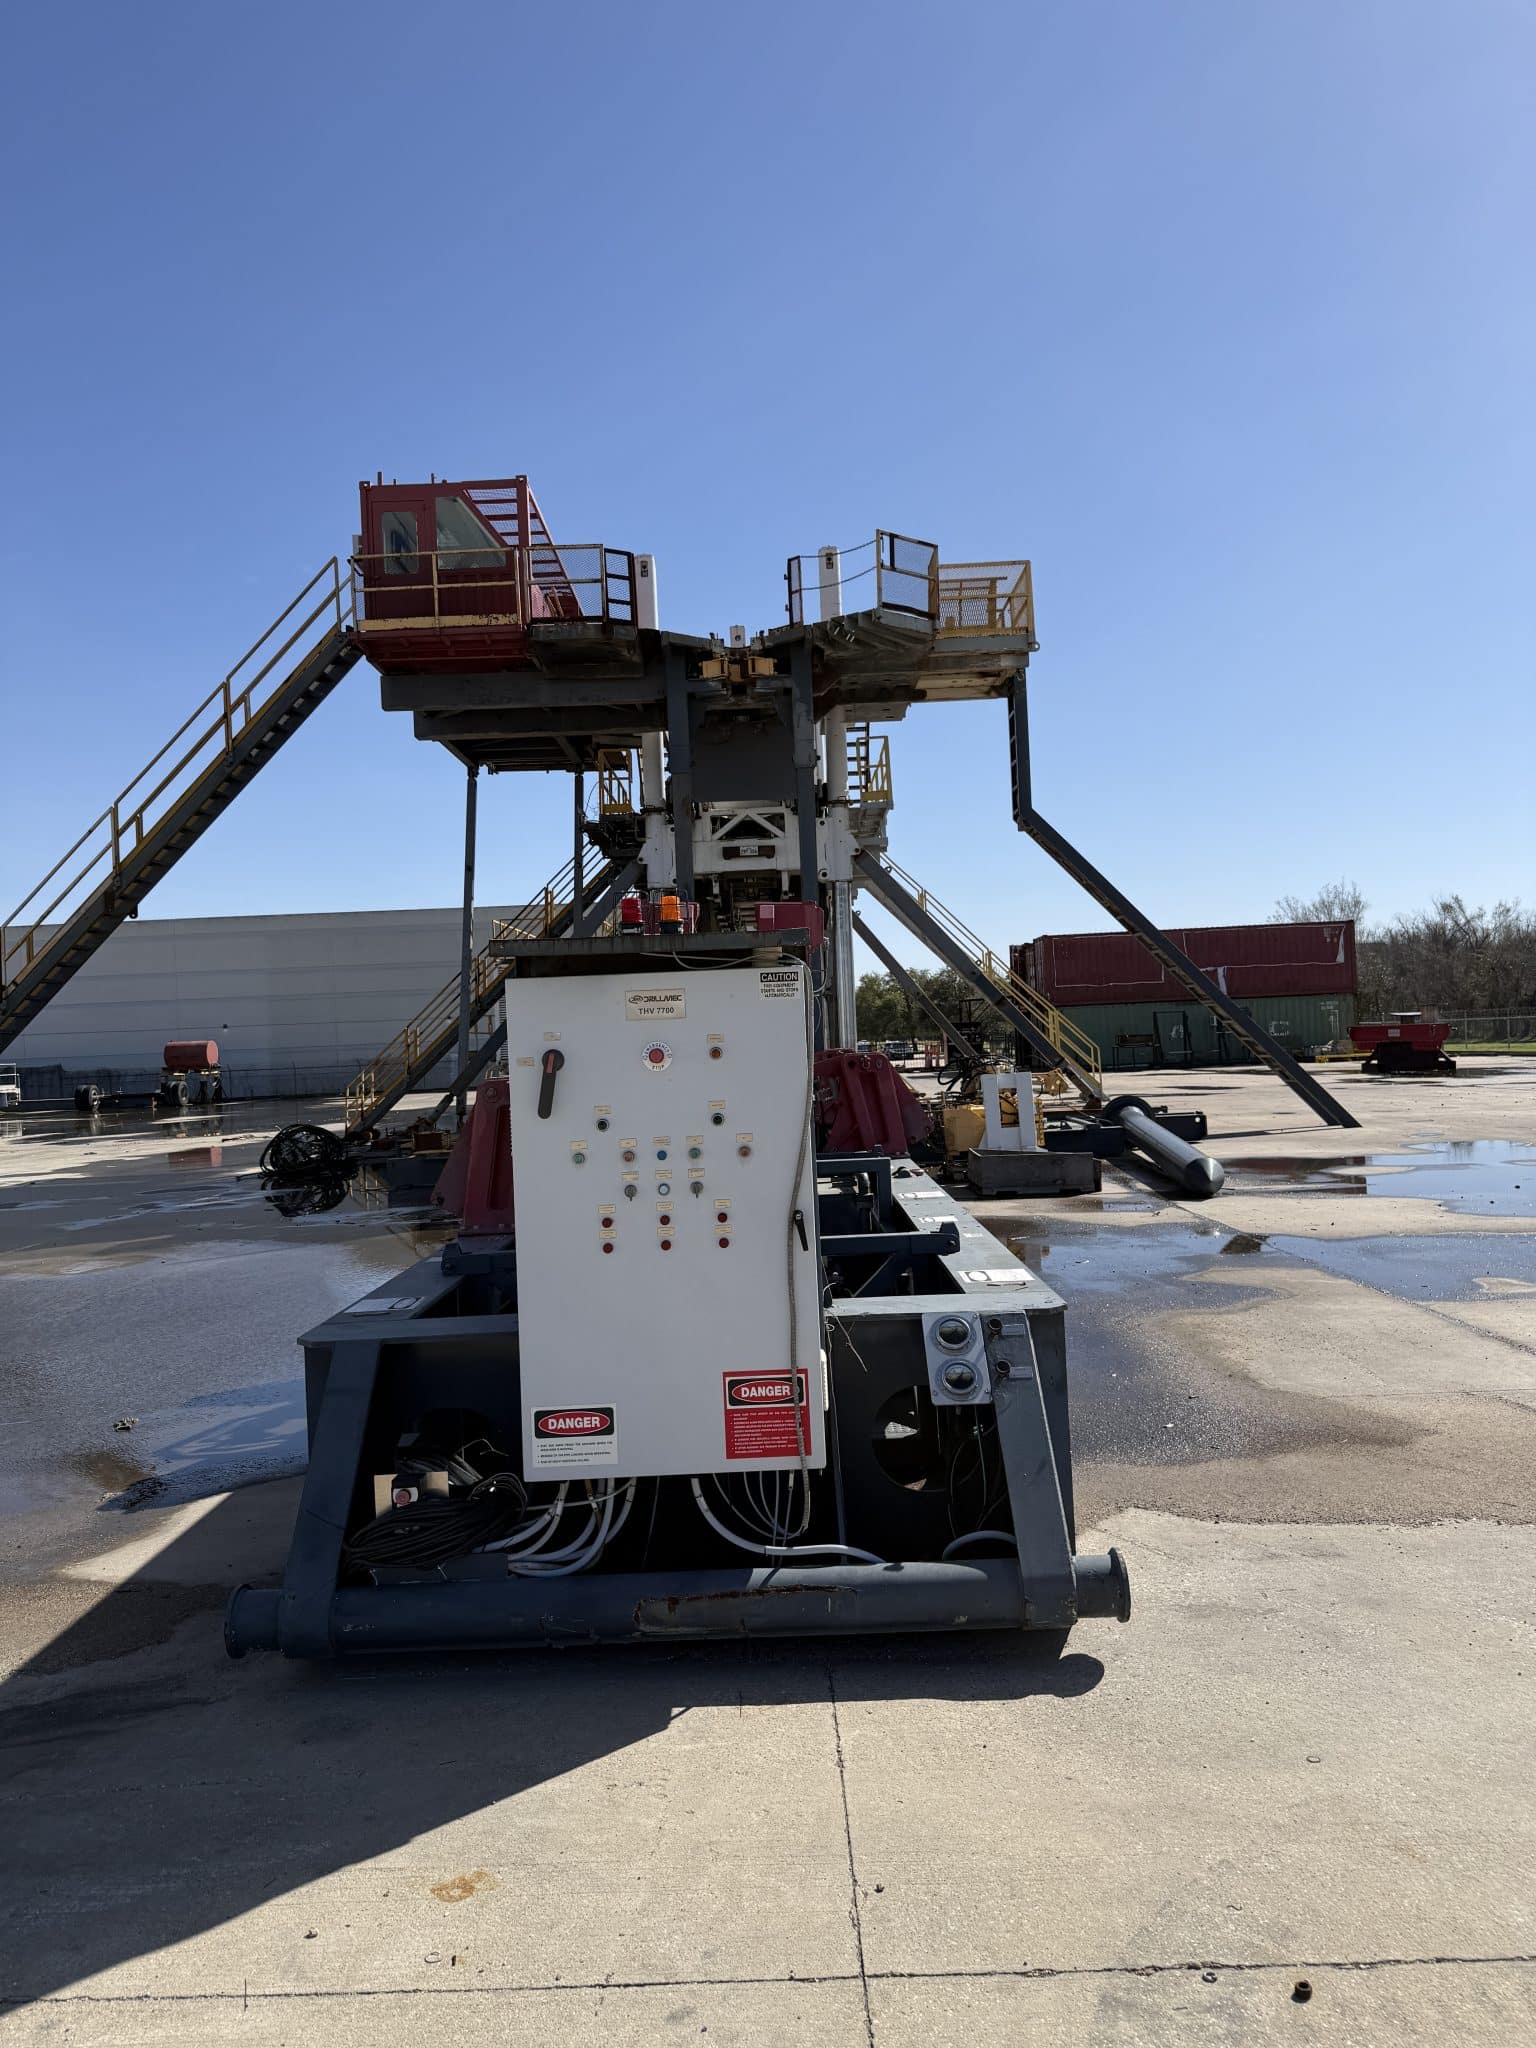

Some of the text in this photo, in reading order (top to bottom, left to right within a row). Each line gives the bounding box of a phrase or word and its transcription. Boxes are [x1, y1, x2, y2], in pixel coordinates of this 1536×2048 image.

[761, 973, 797, 981] CAUTION
[639, 1007, 655, 1015] THV
[741, 1385, 791, 1398] DANGER
[548, 1416, 601, 1430] DANGER
